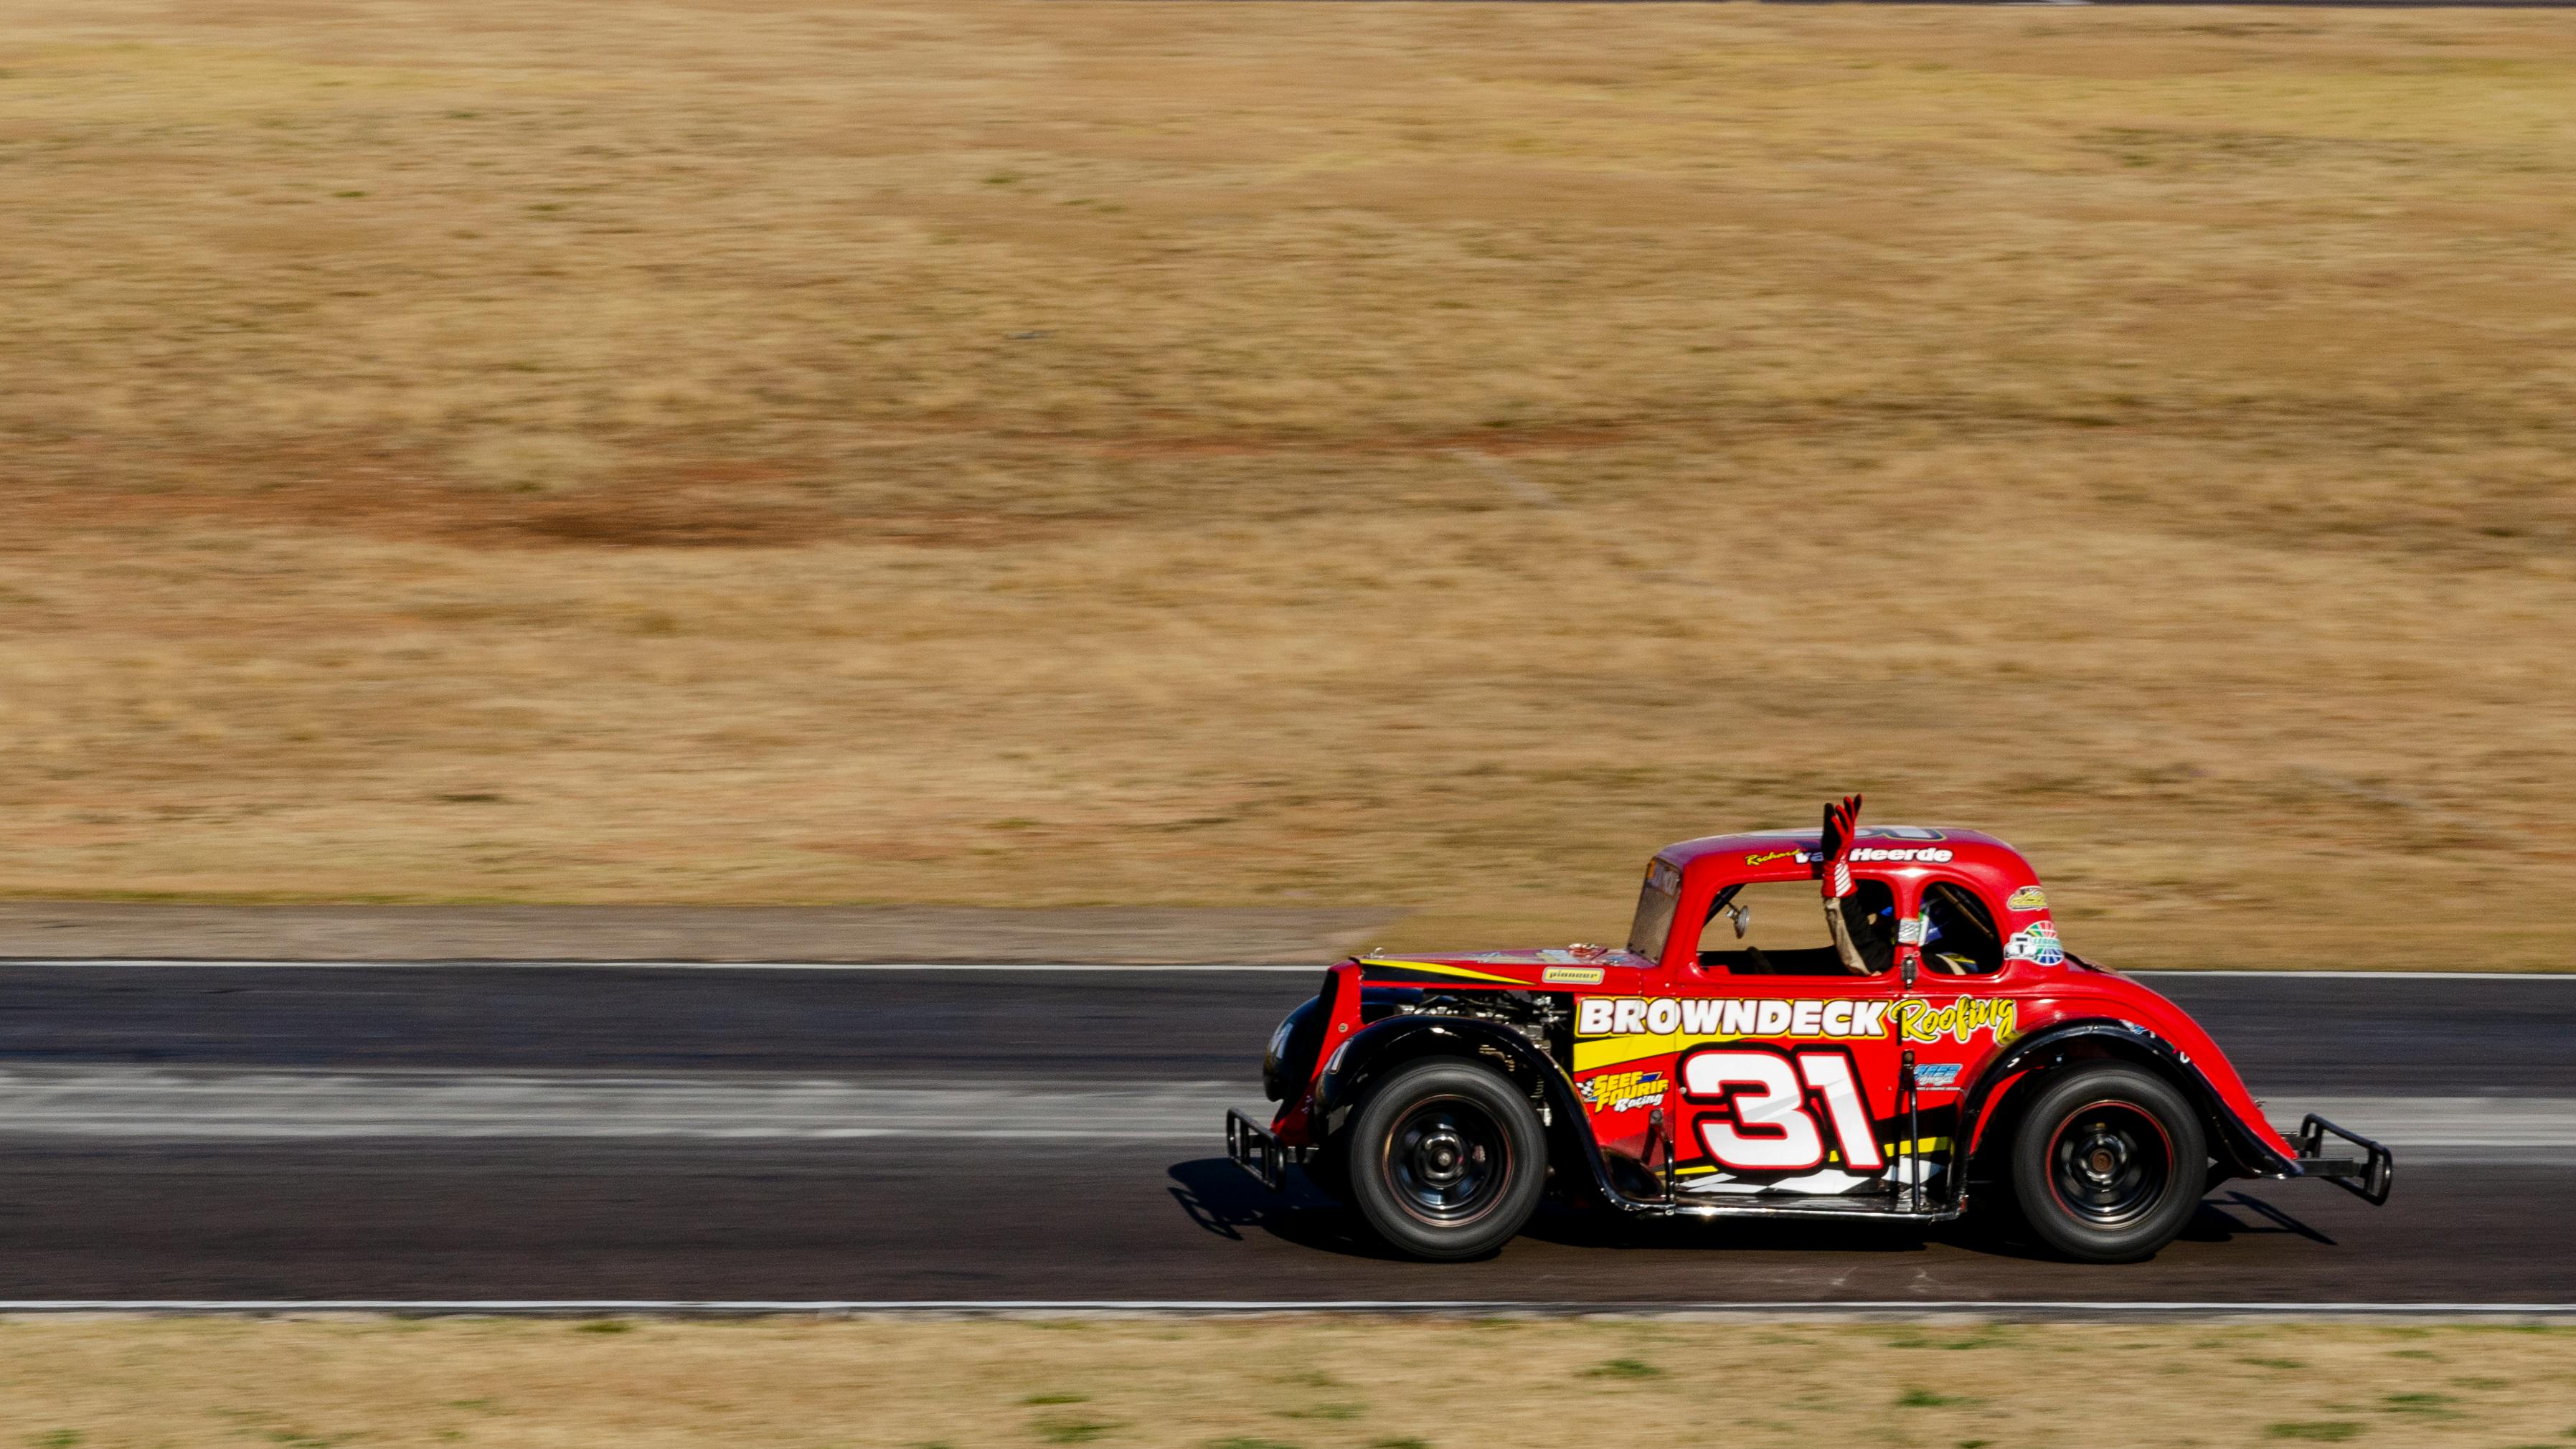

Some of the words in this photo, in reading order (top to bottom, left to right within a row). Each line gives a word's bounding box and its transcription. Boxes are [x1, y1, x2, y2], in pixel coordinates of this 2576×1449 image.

[1795, 851, 1825, 864] va
[1849, 847, 1953, 863] Heerde
[1578, 998, 1889, 1035] BROWNDECK
[1890, 996, 2014, 1045] Roofing
[1593, 1071, 1643, 1097] SEEF
[1614, 1093, 1665, 1113] Racing
[1681, 1049, 1884, 1171] 31
